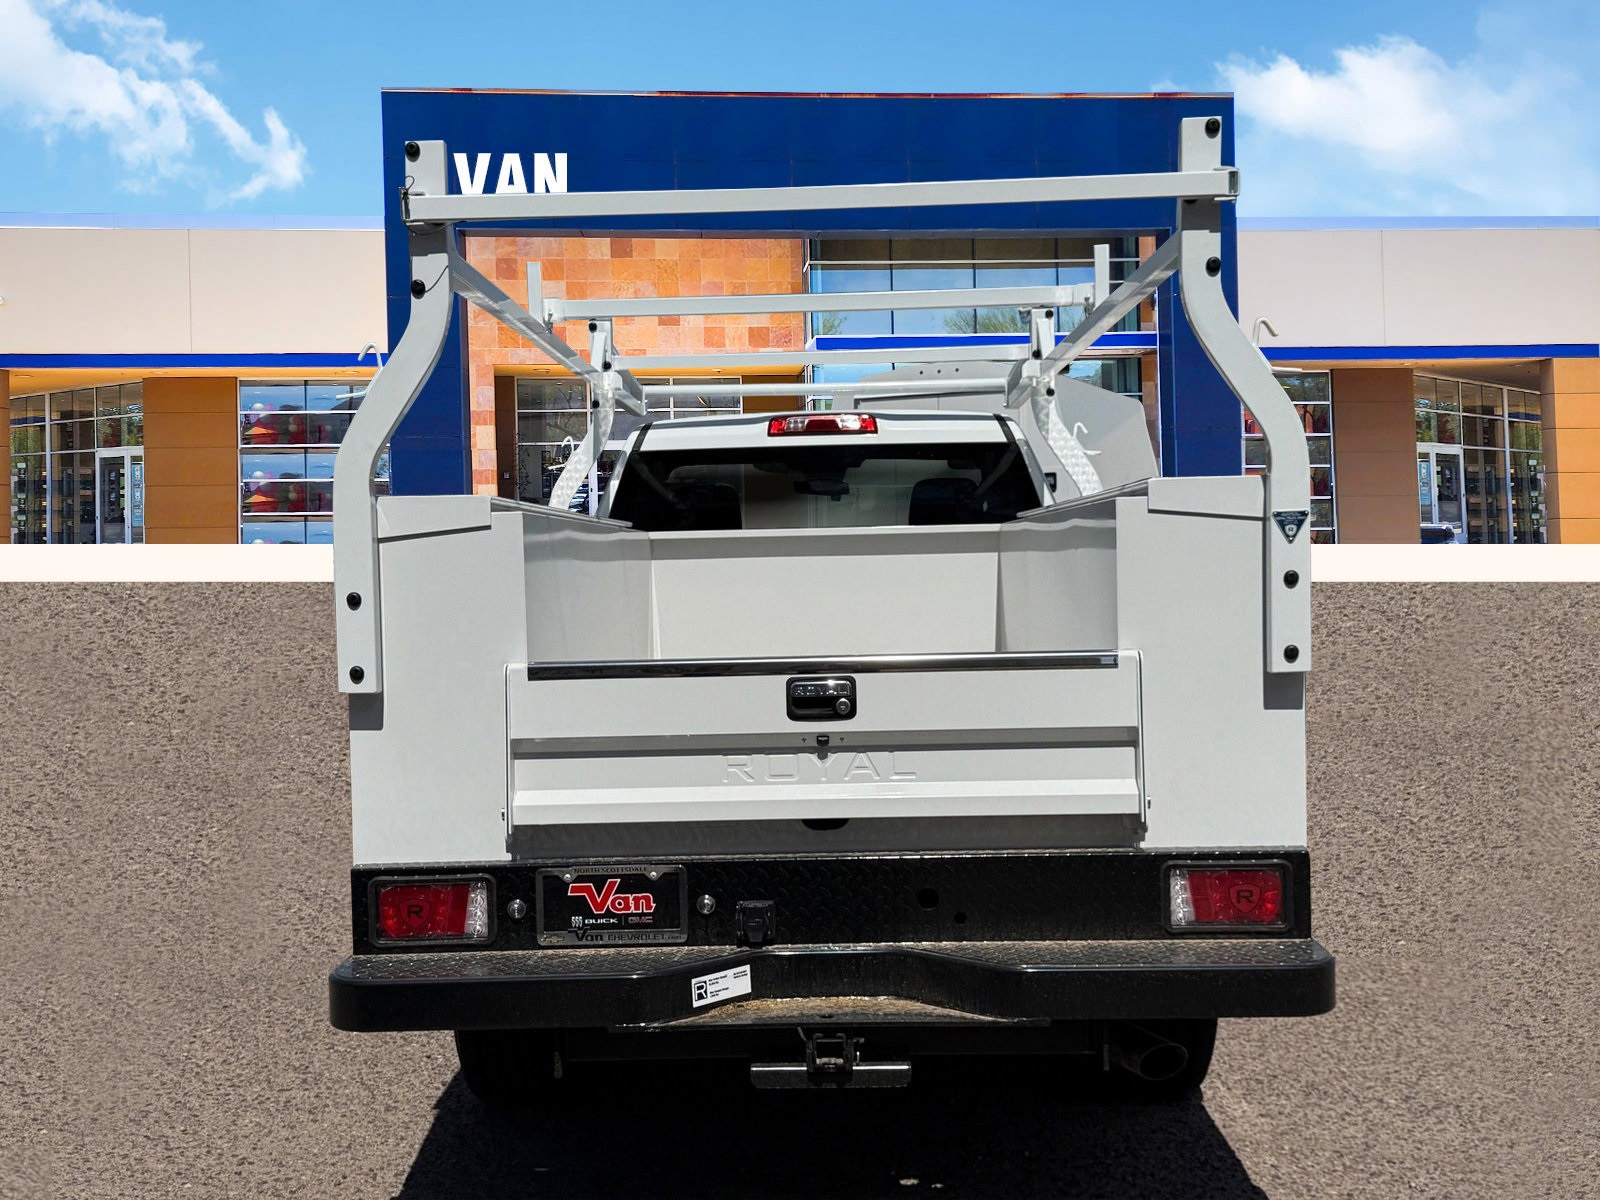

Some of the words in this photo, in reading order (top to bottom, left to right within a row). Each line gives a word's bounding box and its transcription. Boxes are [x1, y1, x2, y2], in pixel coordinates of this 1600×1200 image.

[453, 152, 568, 195] VAN
[721, 751, 919, 783] ROYAL
[567, 878, 656, 914] Van
[568, 927, 604, 942] Van
[694, 983, 707, 1000] R
